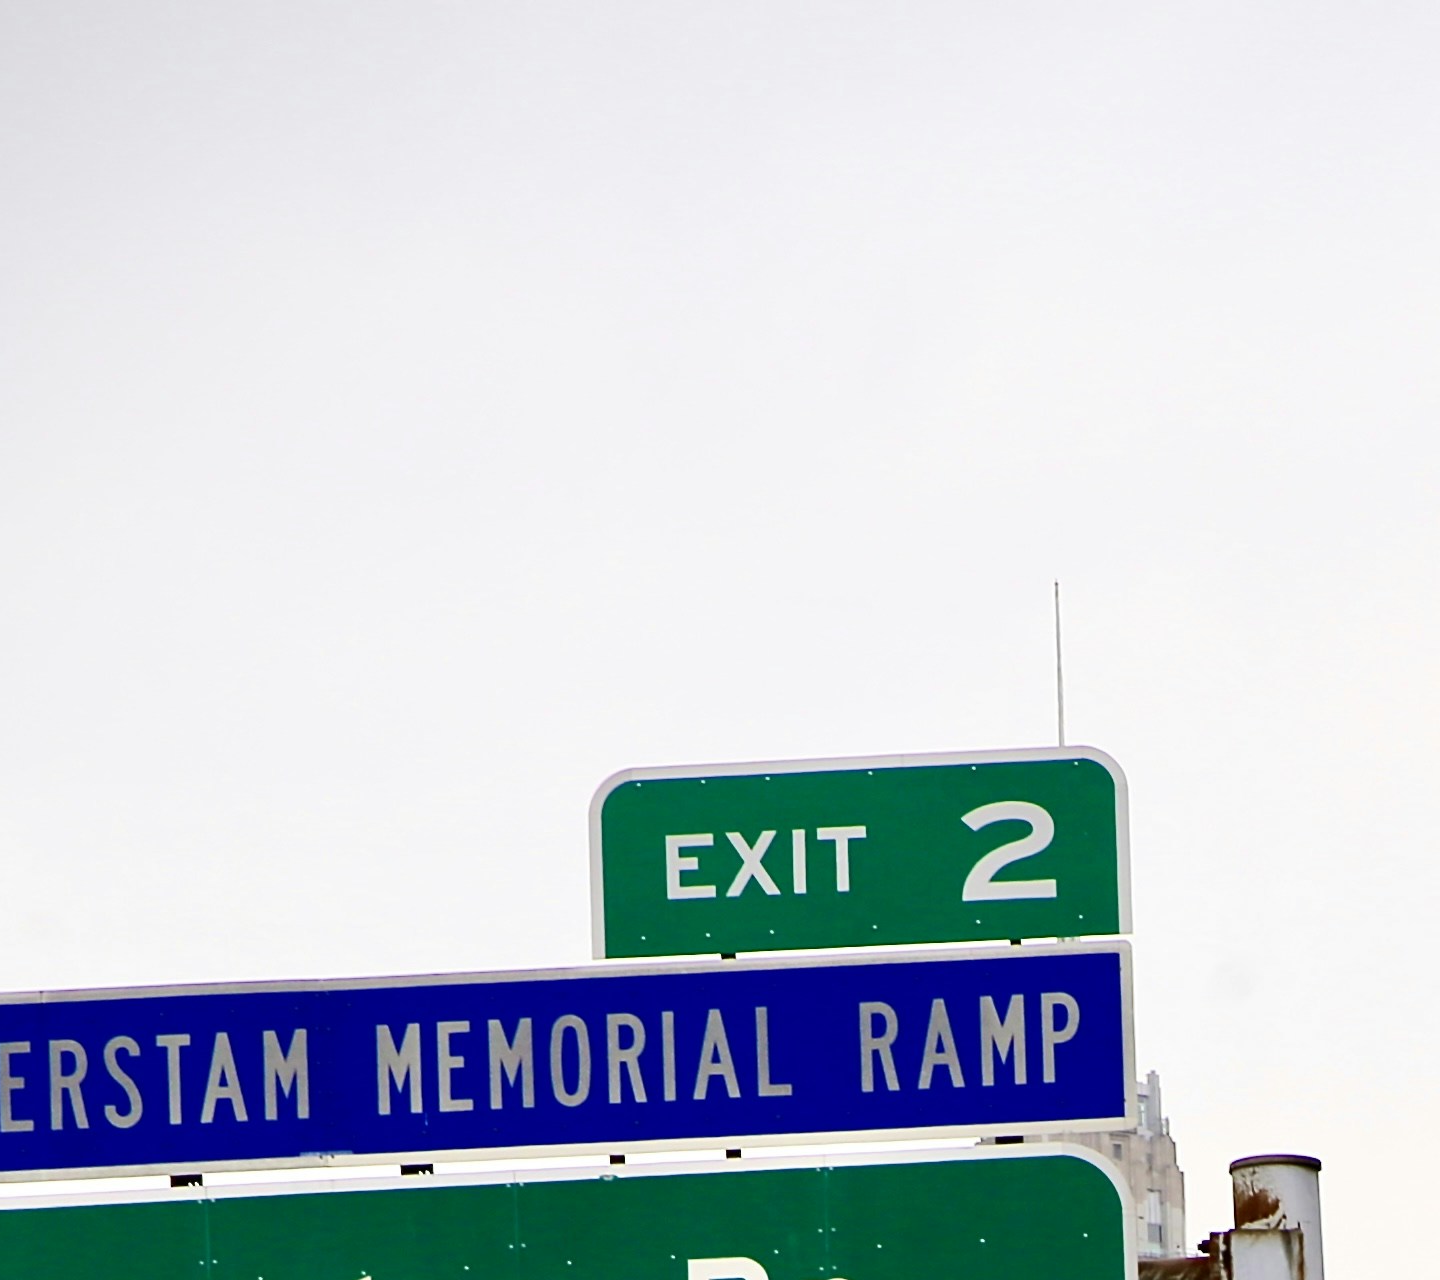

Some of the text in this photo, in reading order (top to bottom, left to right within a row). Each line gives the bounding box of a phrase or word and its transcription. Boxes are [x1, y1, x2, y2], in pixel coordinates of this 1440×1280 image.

[665, 800, 1059, 902] EXIT 2
[376, 1006, 794, 1117] MEMORIAL
[859, 991, 1081, 1093] RAMP
